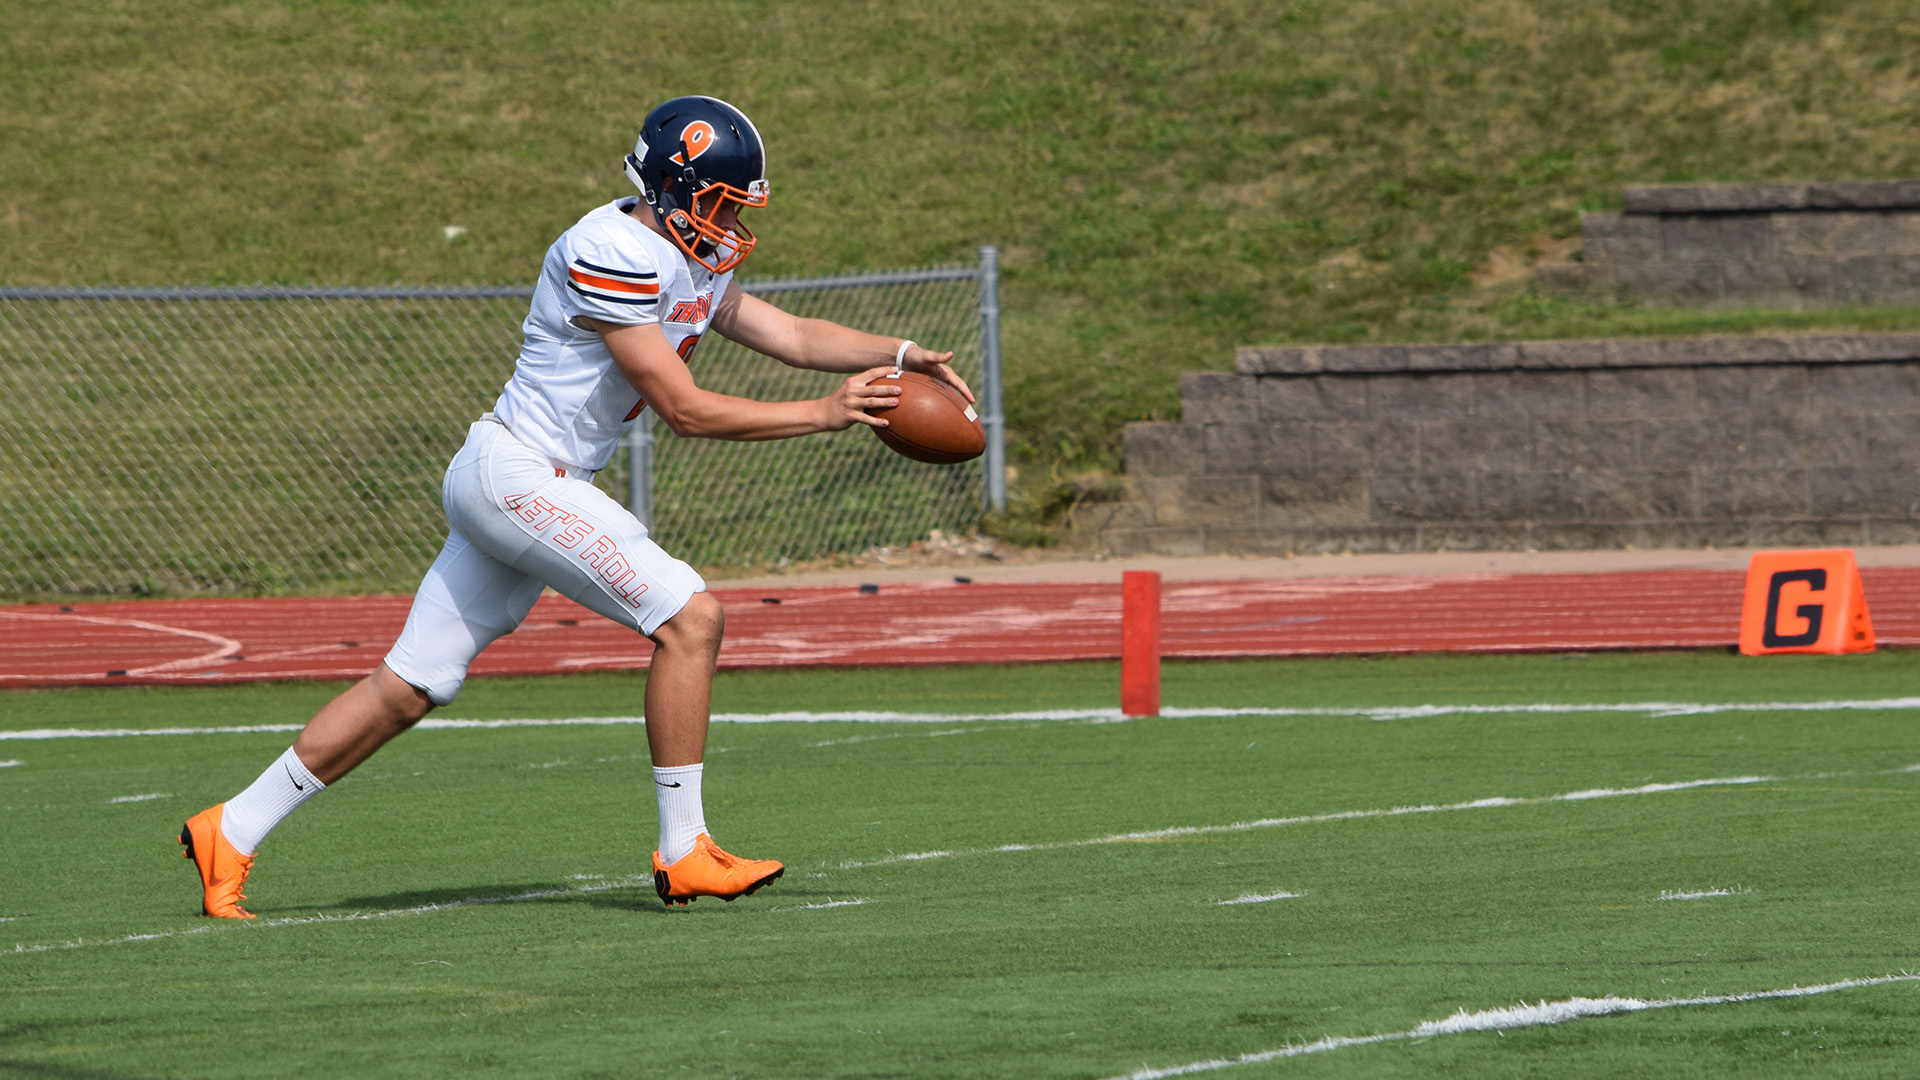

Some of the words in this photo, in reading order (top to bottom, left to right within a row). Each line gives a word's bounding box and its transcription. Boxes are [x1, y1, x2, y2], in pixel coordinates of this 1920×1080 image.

[504, 490, 595, 549] LET'S
[579, 535, 649, 609] ROLL
[1762, 568, 1827, 648] G
